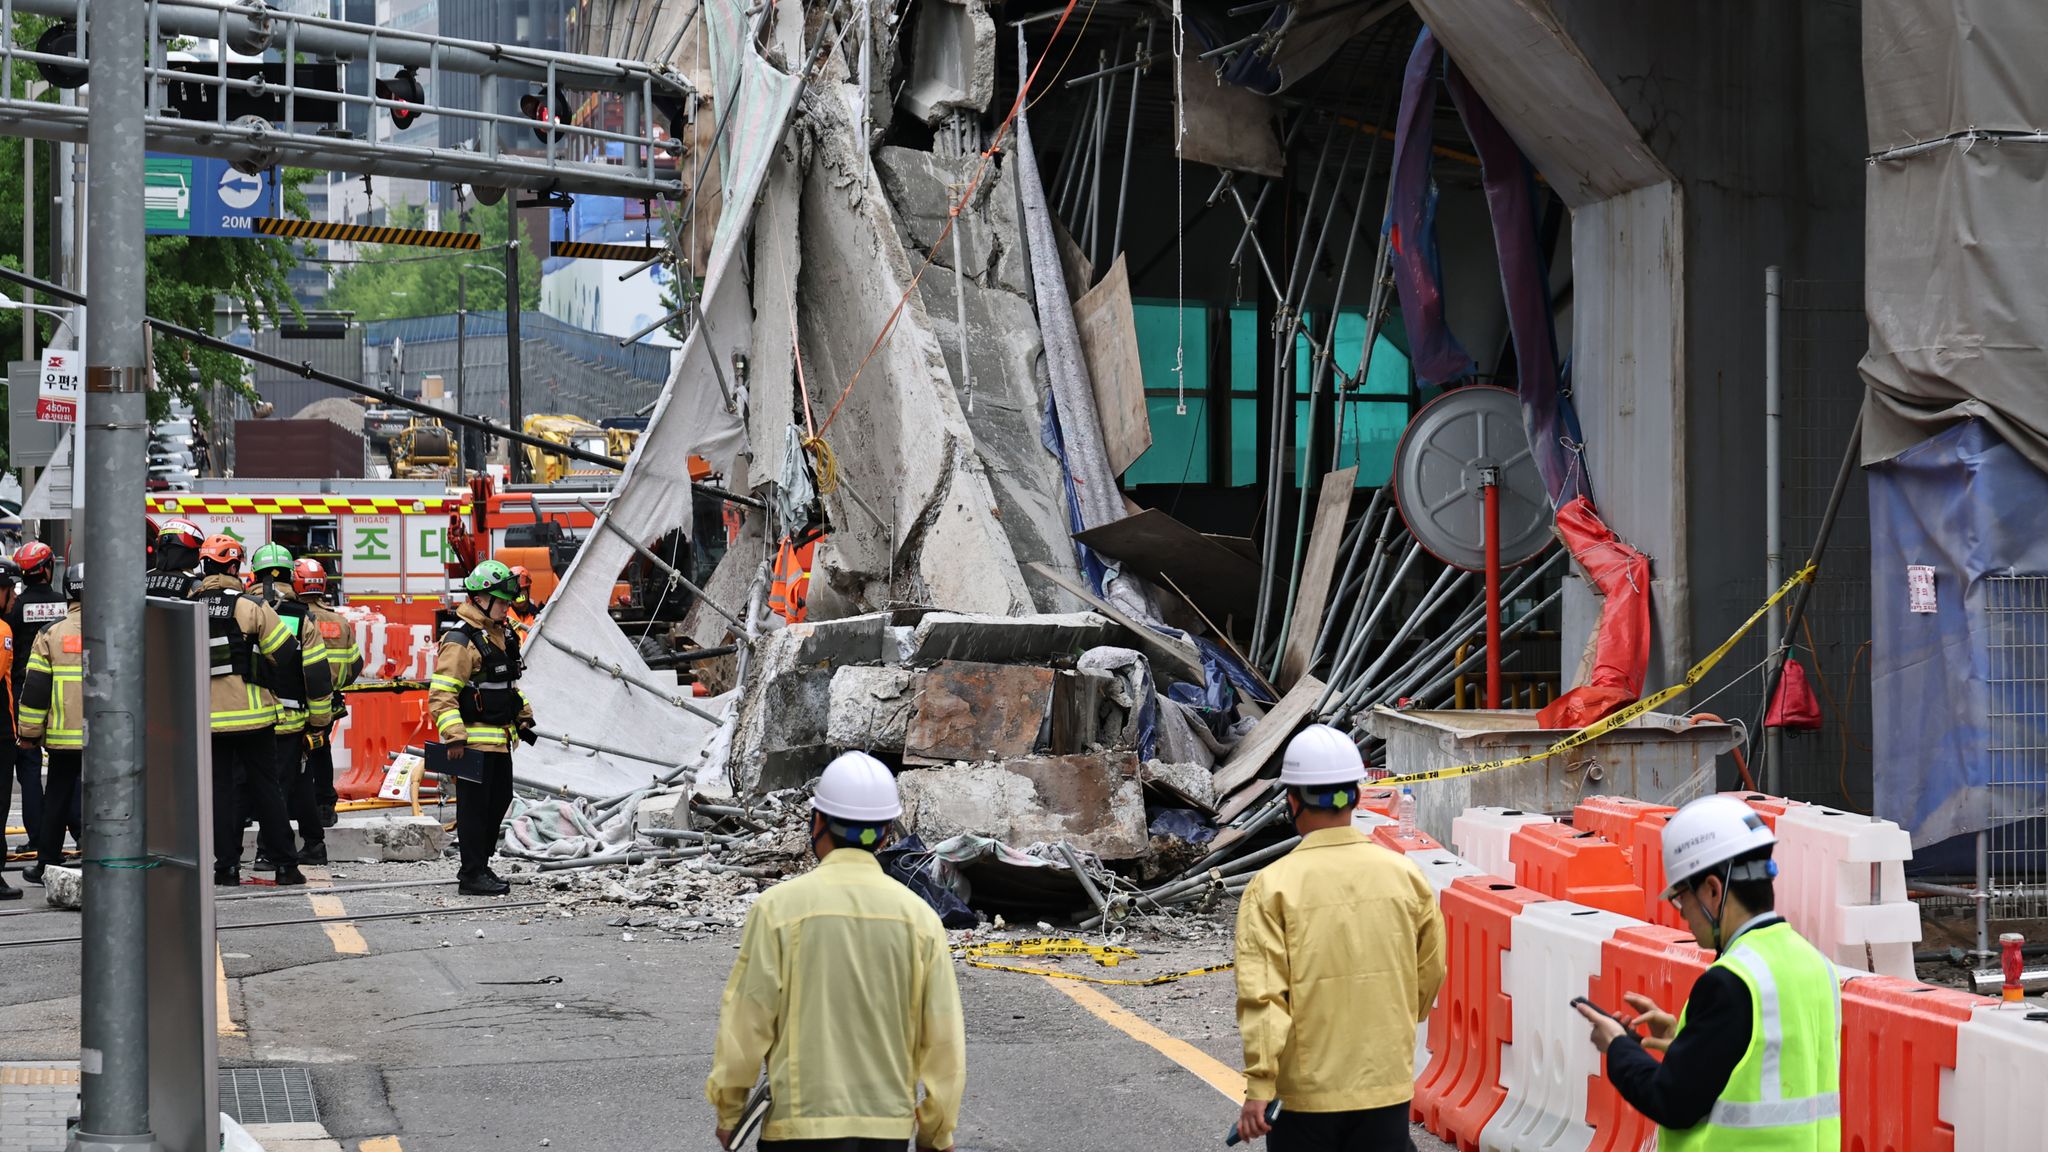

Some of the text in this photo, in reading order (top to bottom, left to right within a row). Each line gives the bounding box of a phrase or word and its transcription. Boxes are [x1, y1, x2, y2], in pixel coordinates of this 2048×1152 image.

[221, 216, 252, 229] 20M
[209, 515, 390, 524] SPECIAL BRIGADE
